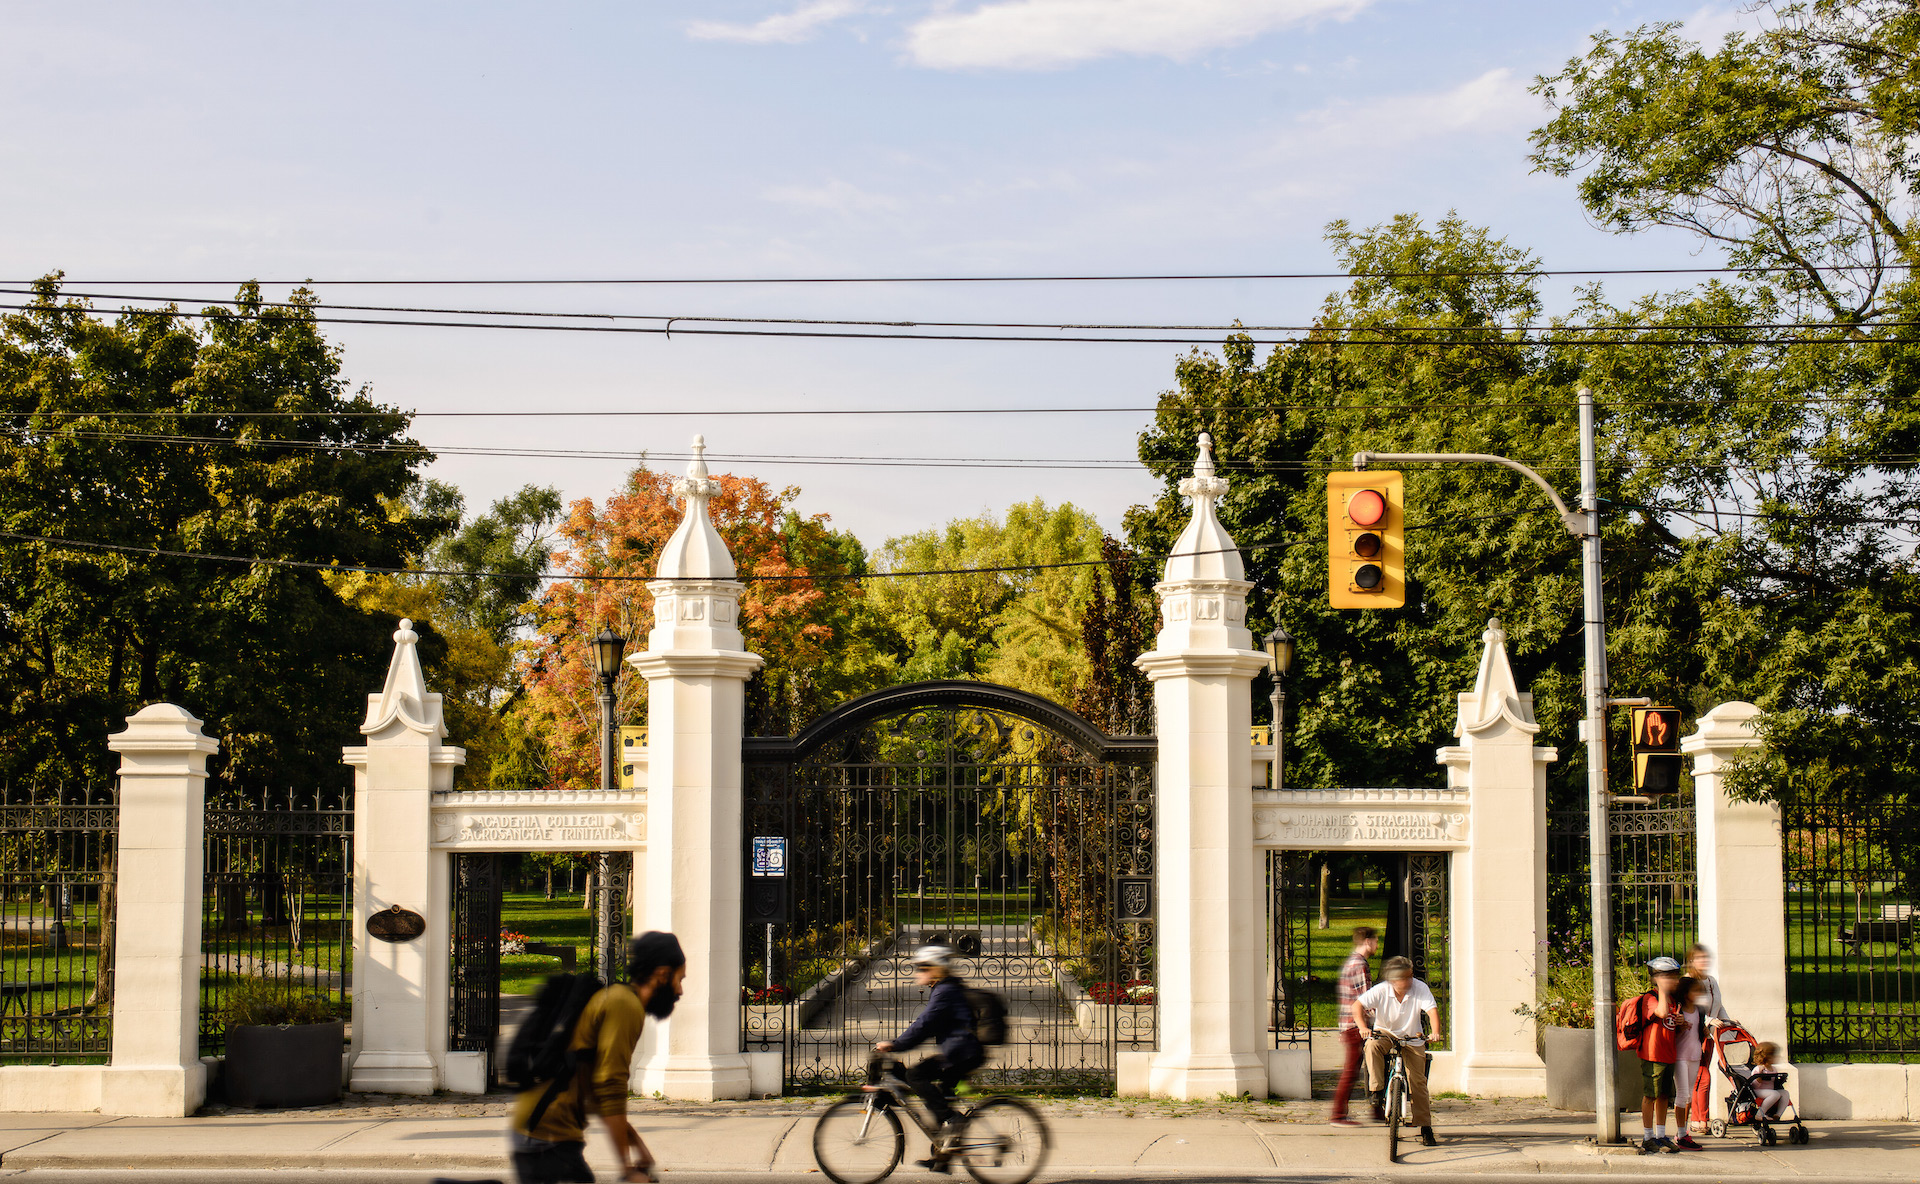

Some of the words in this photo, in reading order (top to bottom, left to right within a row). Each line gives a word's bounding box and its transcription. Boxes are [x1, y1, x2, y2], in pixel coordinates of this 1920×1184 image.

[477, 815, 541, 829] ACADEMIA
[1291, 813, 1358, 827] JOHANNES
[1366, 814, 1430, 828] STRACHAN
[460, 828, 553, 841] SACROSANCTAE
[558, 827, 621, 841] TRINITATIS
[1282, 827, 1349, 840] FUNDATOR
